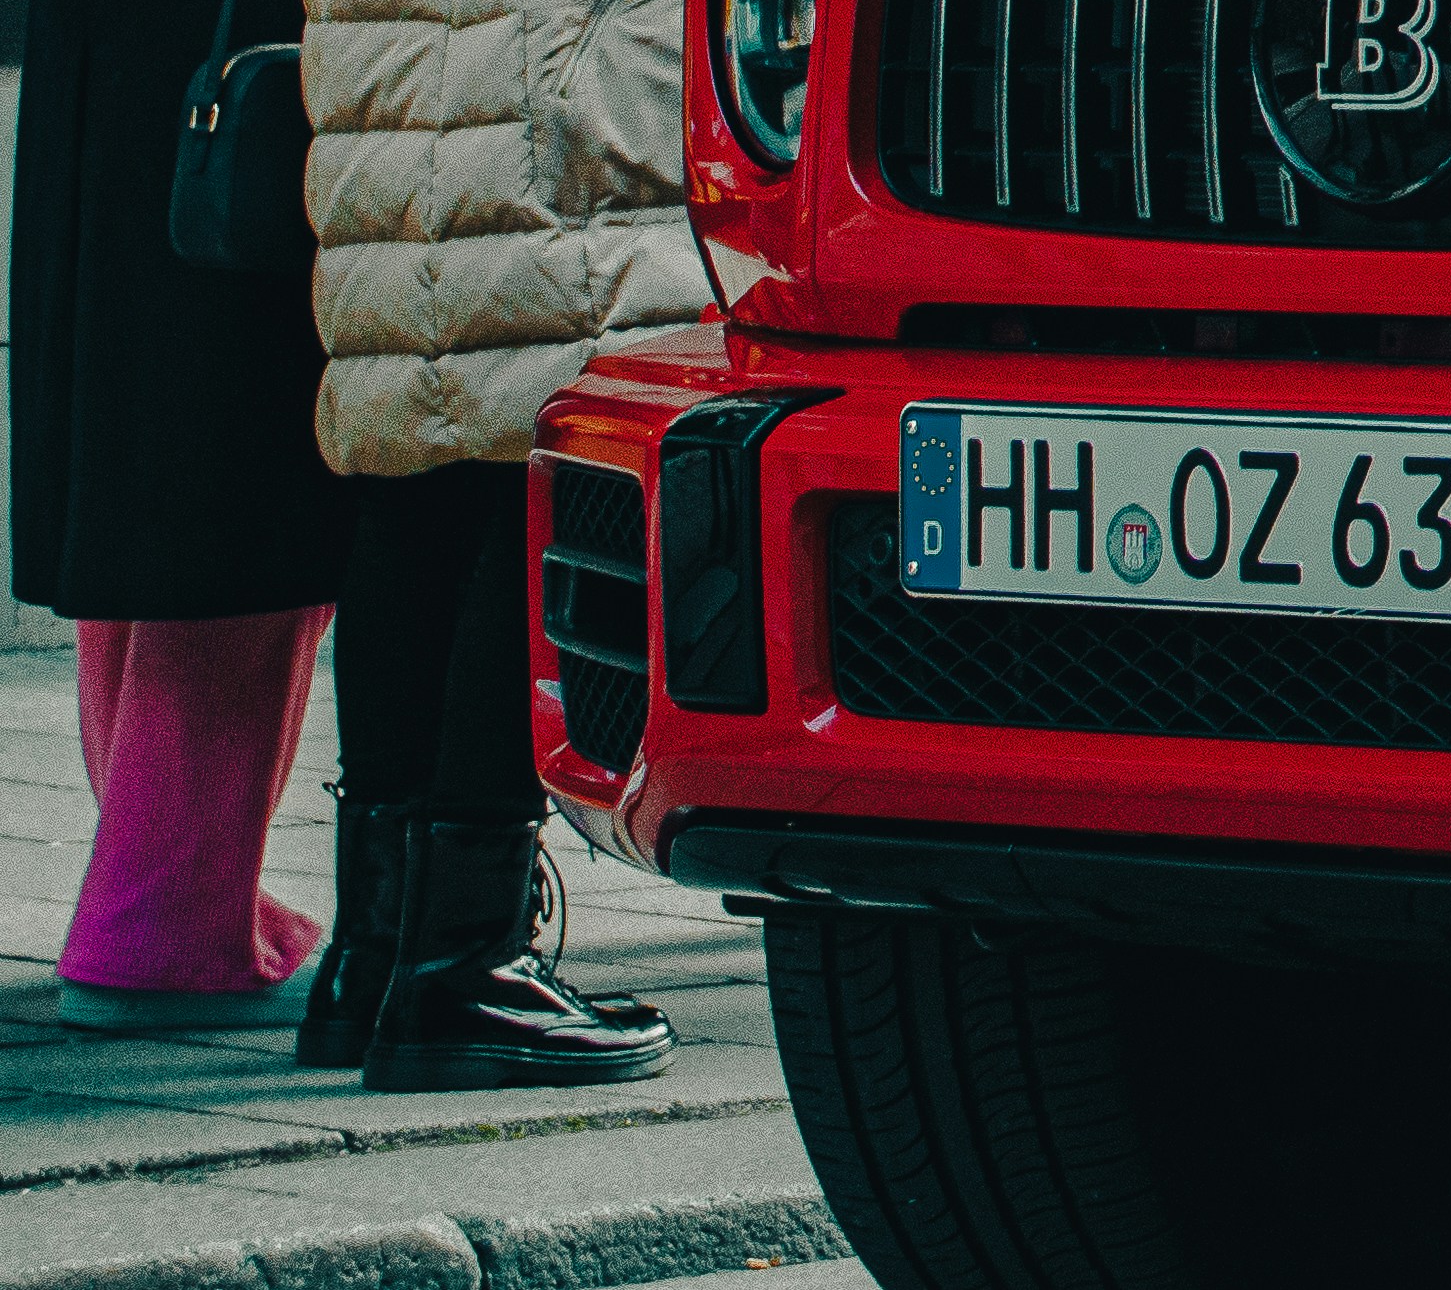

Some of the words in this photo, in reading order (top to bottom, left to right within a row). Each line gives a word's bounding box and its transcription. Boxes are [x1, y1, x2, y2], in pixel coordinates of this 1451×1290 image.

[923, 520, 943, 556] D
[967, 437, 1095, 574] HH
[1169, 447, 1302, 586] OZ
